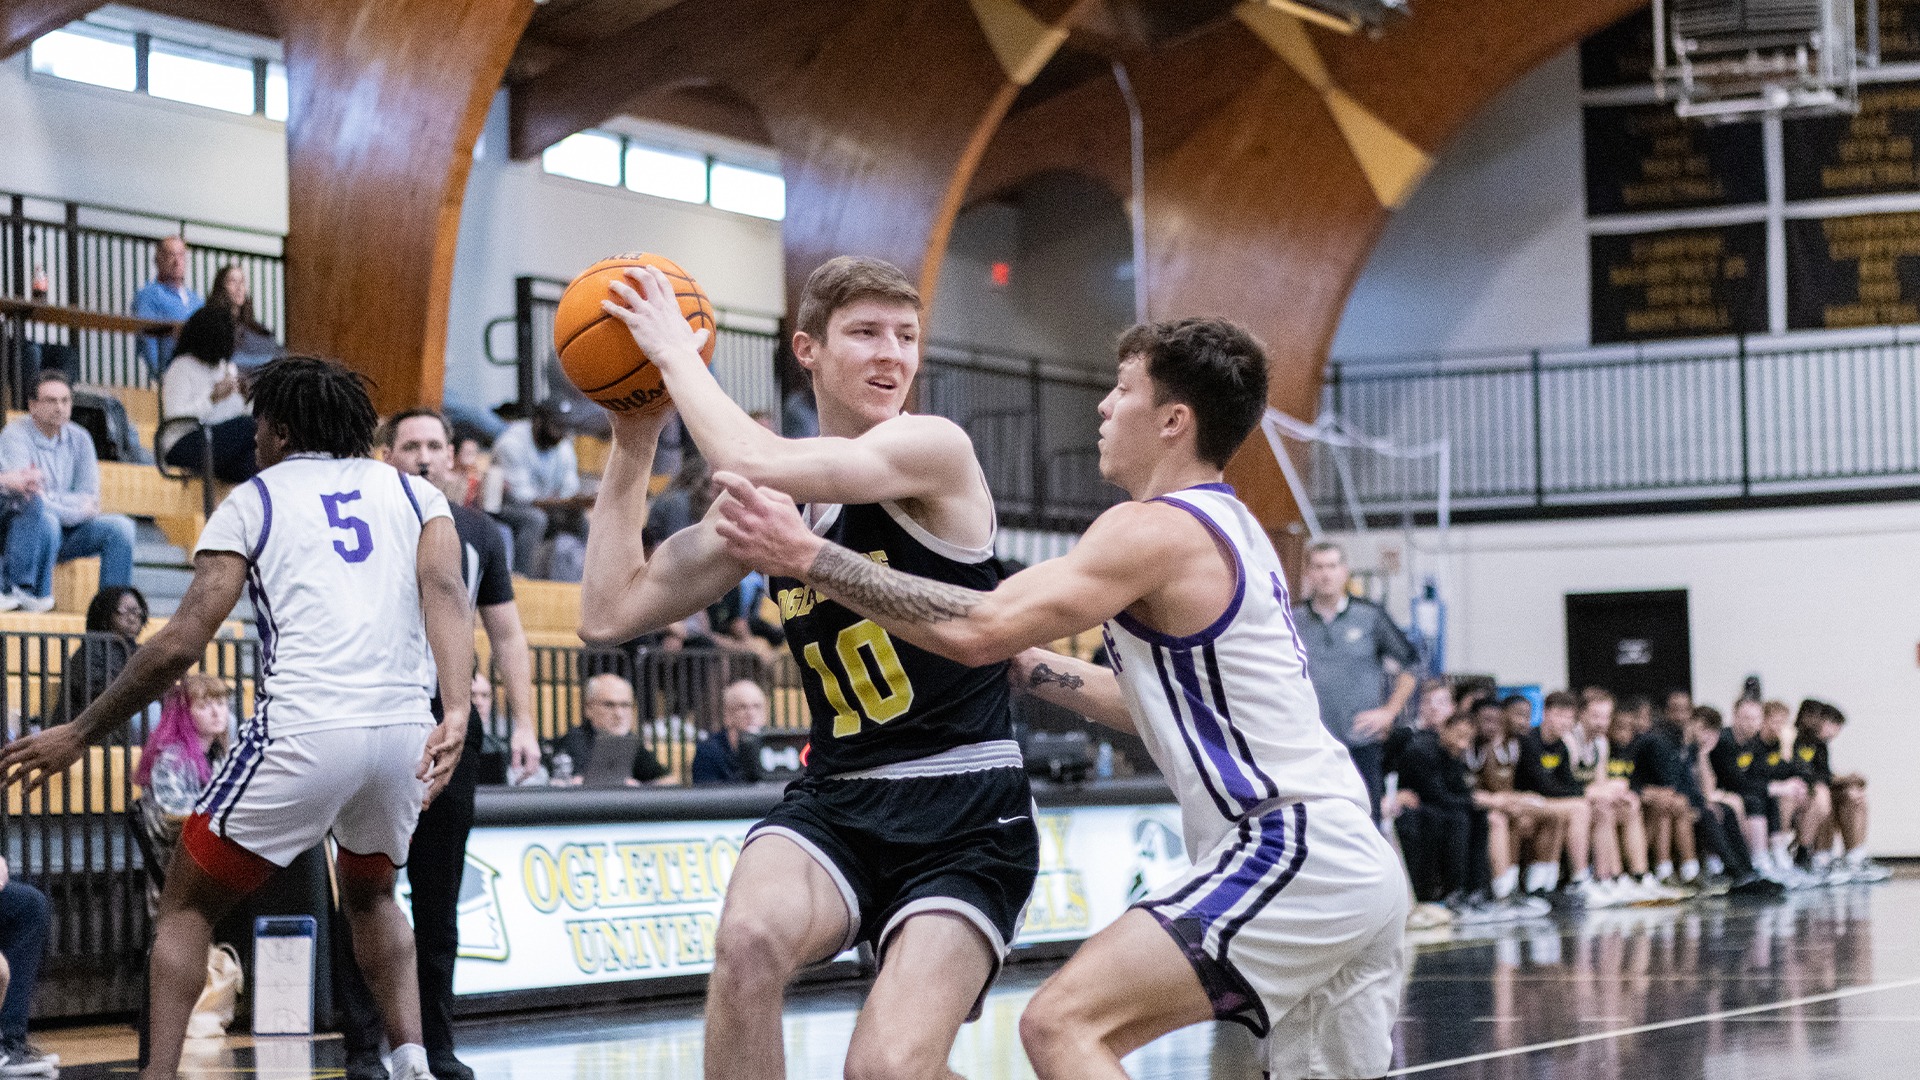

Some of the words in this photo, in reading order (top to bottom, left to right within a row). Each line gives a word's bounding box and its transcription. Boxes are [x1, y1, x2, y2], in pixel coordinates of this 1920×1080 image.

[597, 379, 667, 412] Wils
[320, 489, 374, 563] 5
[804, 619, 914, 738] 10
[522, 836, 742, 913] OGLETHO
